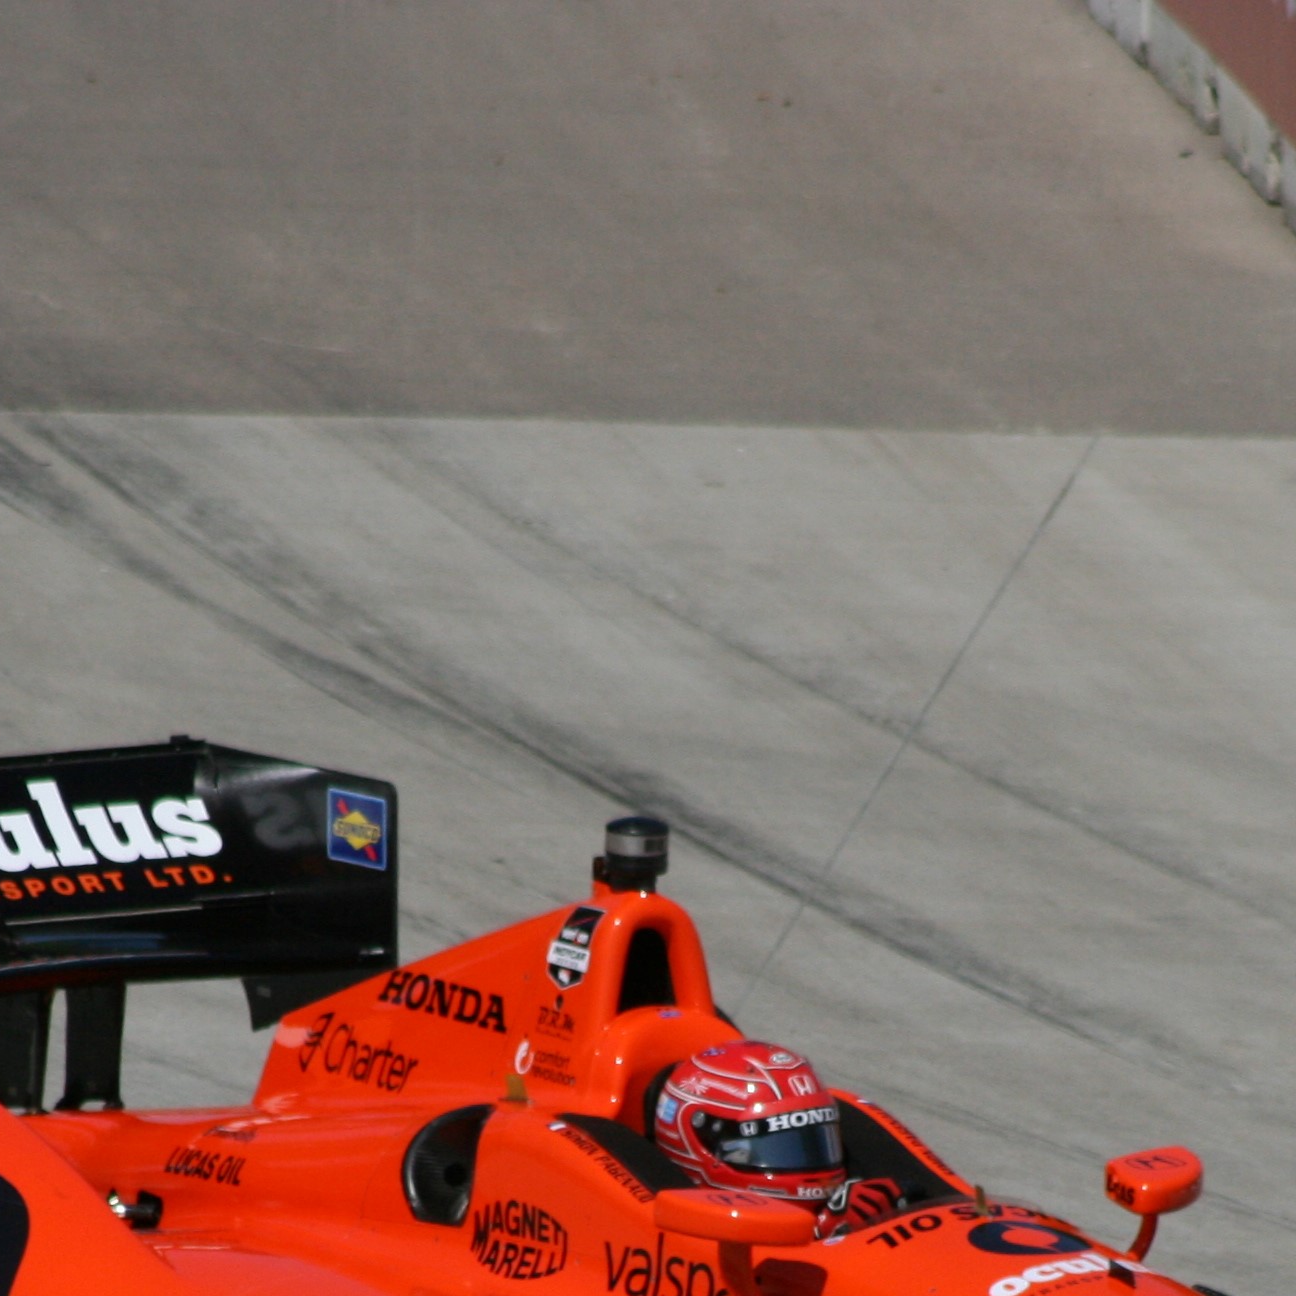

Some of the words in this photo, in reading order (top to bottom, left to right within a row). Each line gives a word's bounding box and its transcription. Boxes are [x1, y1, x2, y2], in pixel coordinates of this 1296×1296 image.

[144, 863, 233, 889] LTD.
[377, 968, 507, 1034] HONDA
[324, 1022, 419, 1095] Charter
[766, 1107, 839, 1132] HOND
[164, 1148, 220, 1180] LUCAS
[215, 1156, 246, 1186] OIL
